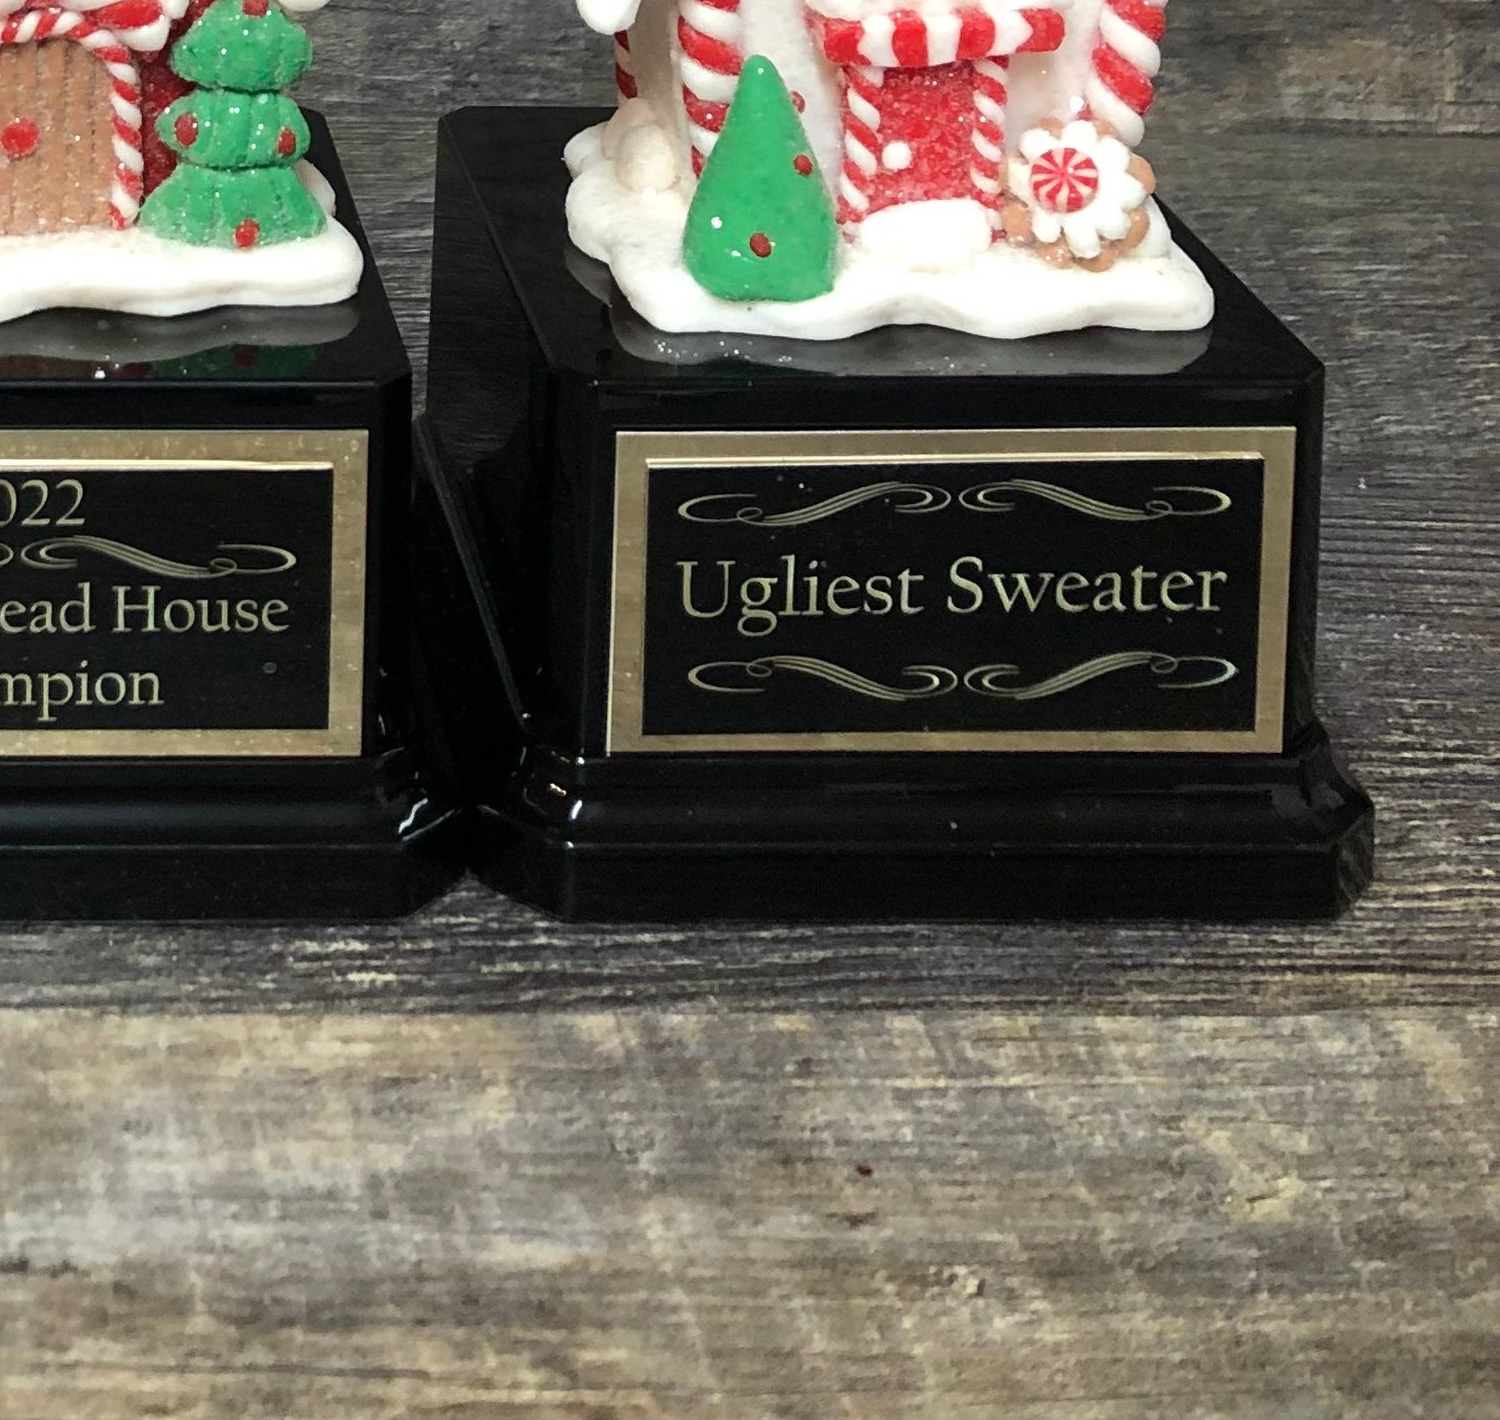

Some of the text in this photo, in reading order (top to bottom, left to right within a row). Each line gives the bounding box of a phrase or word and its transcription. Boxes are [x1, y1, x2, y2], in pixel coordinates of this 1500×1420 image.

[112, 585, 289, 633] House
[675, 554, 1228, 637] Ugliest Sweater
